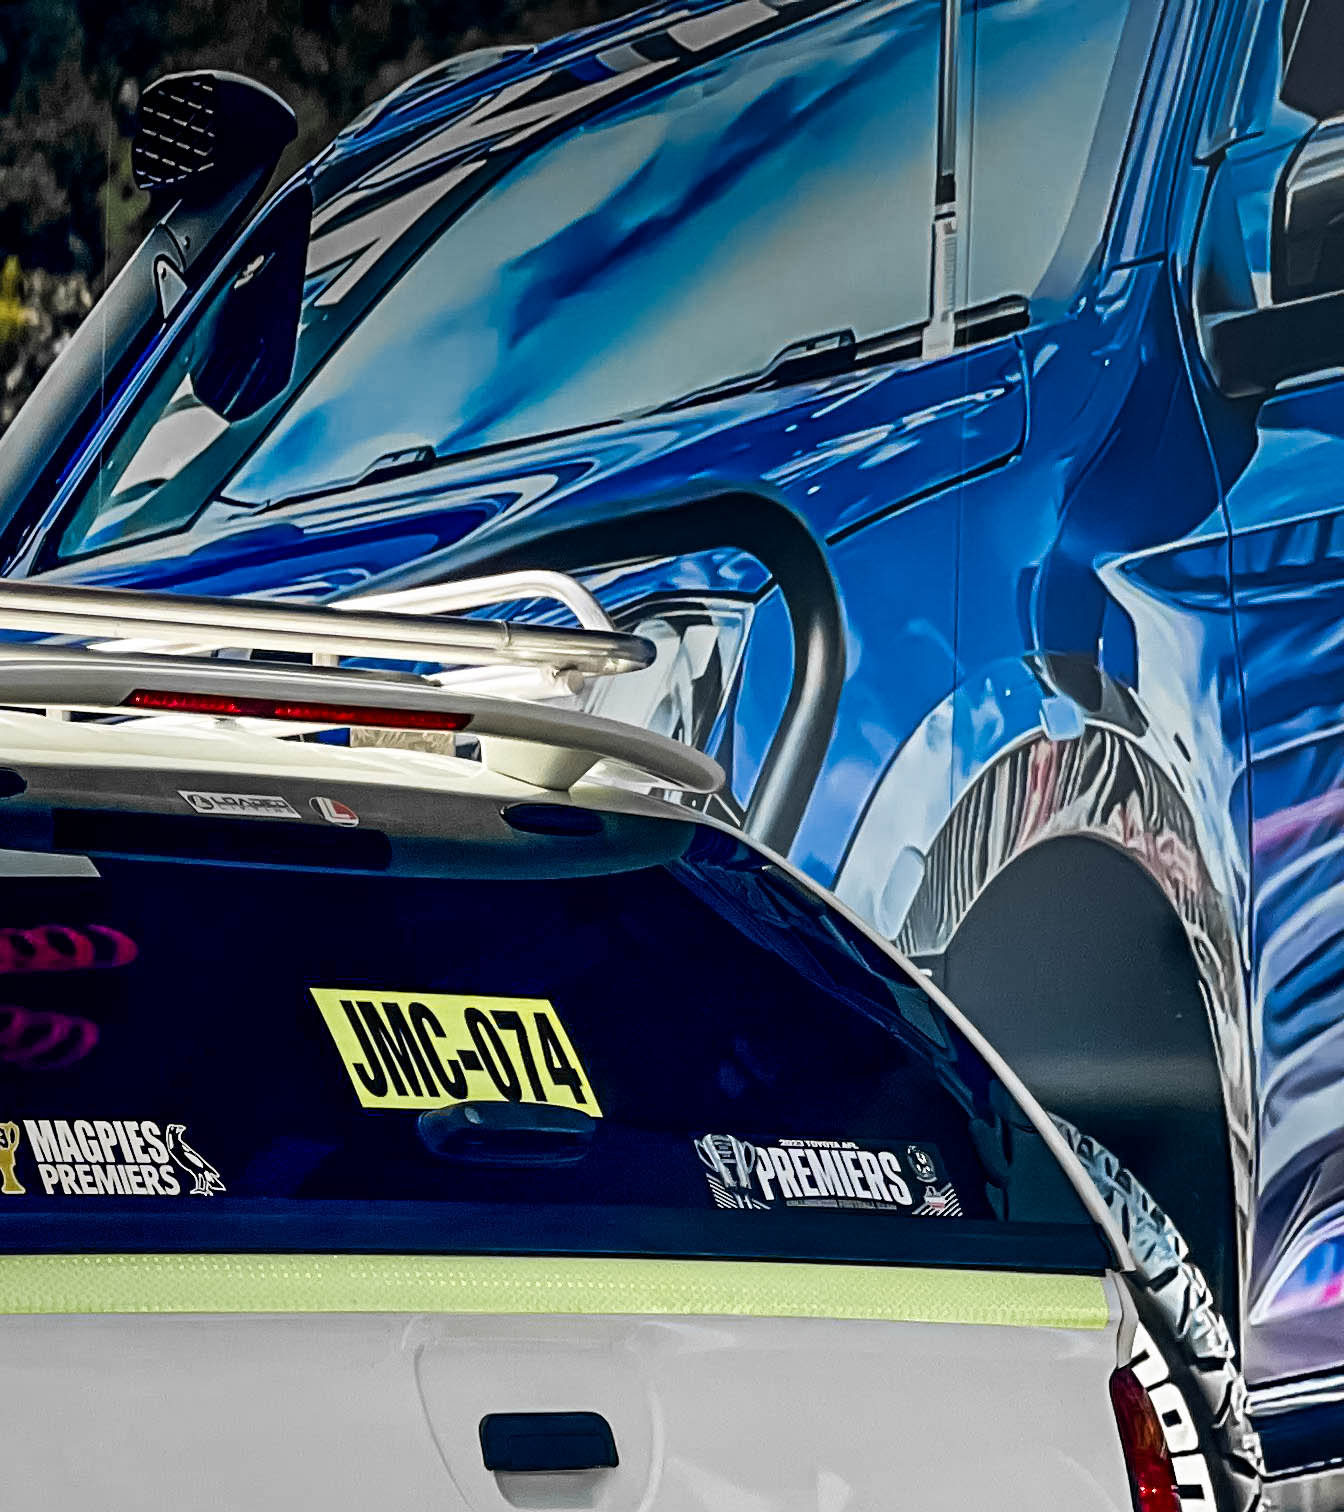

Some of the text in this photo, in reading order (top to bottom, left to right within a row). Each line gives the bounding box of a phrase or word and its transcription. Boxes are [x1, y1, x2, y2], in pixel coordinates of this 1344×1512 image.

[338, 999, 586, 1104] JMC-074
[23, 1119, 170, 1164] MAGPIES
[38, 1164, 181, 1195] PREMIERS
[755, 1147, 913, 1206] PREMIERS
